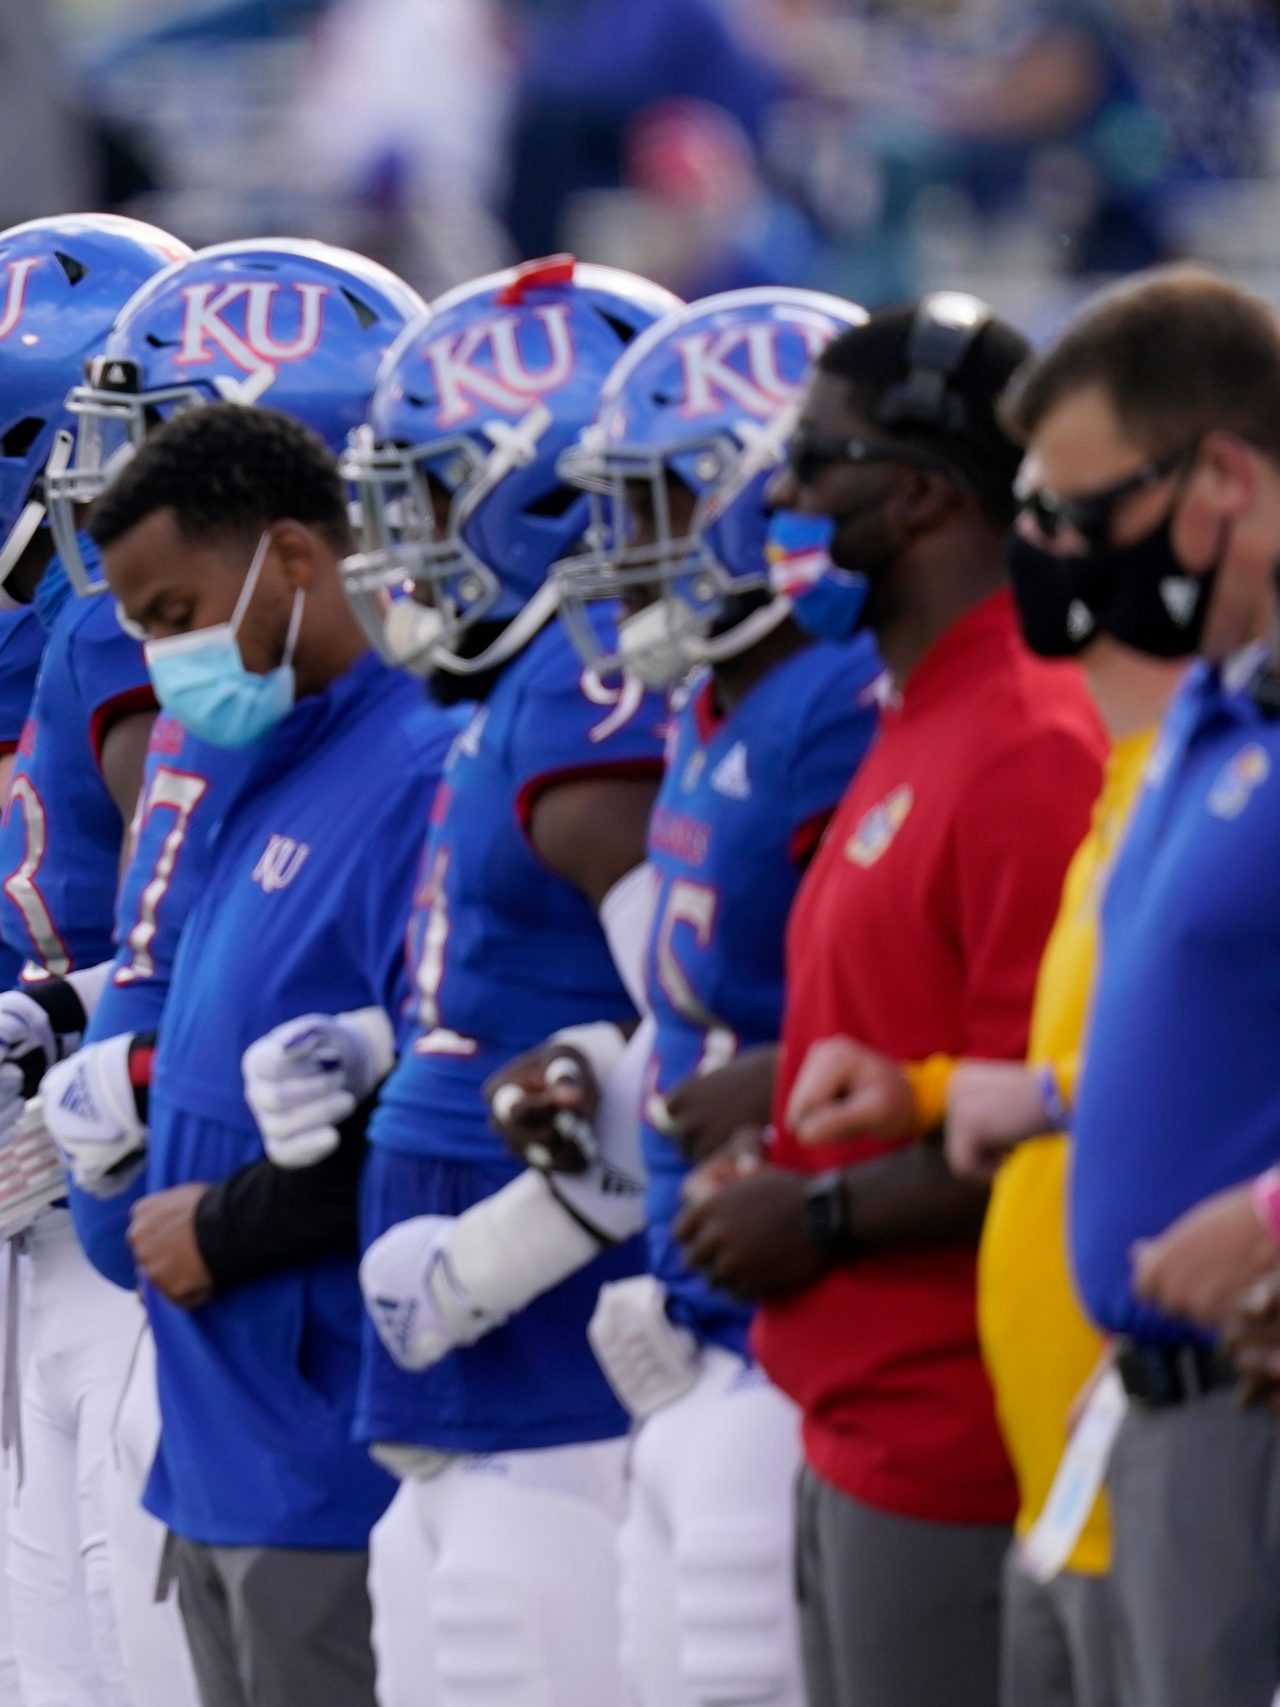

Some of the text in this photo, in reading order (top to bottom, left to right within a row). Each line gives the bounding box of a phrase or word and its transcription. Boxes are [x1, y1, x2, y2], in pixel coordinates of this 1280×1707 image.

[175, 280, 328, 374] KU
[423, 303, 577, 428] KU
[677, 324, 836, 420] KU
